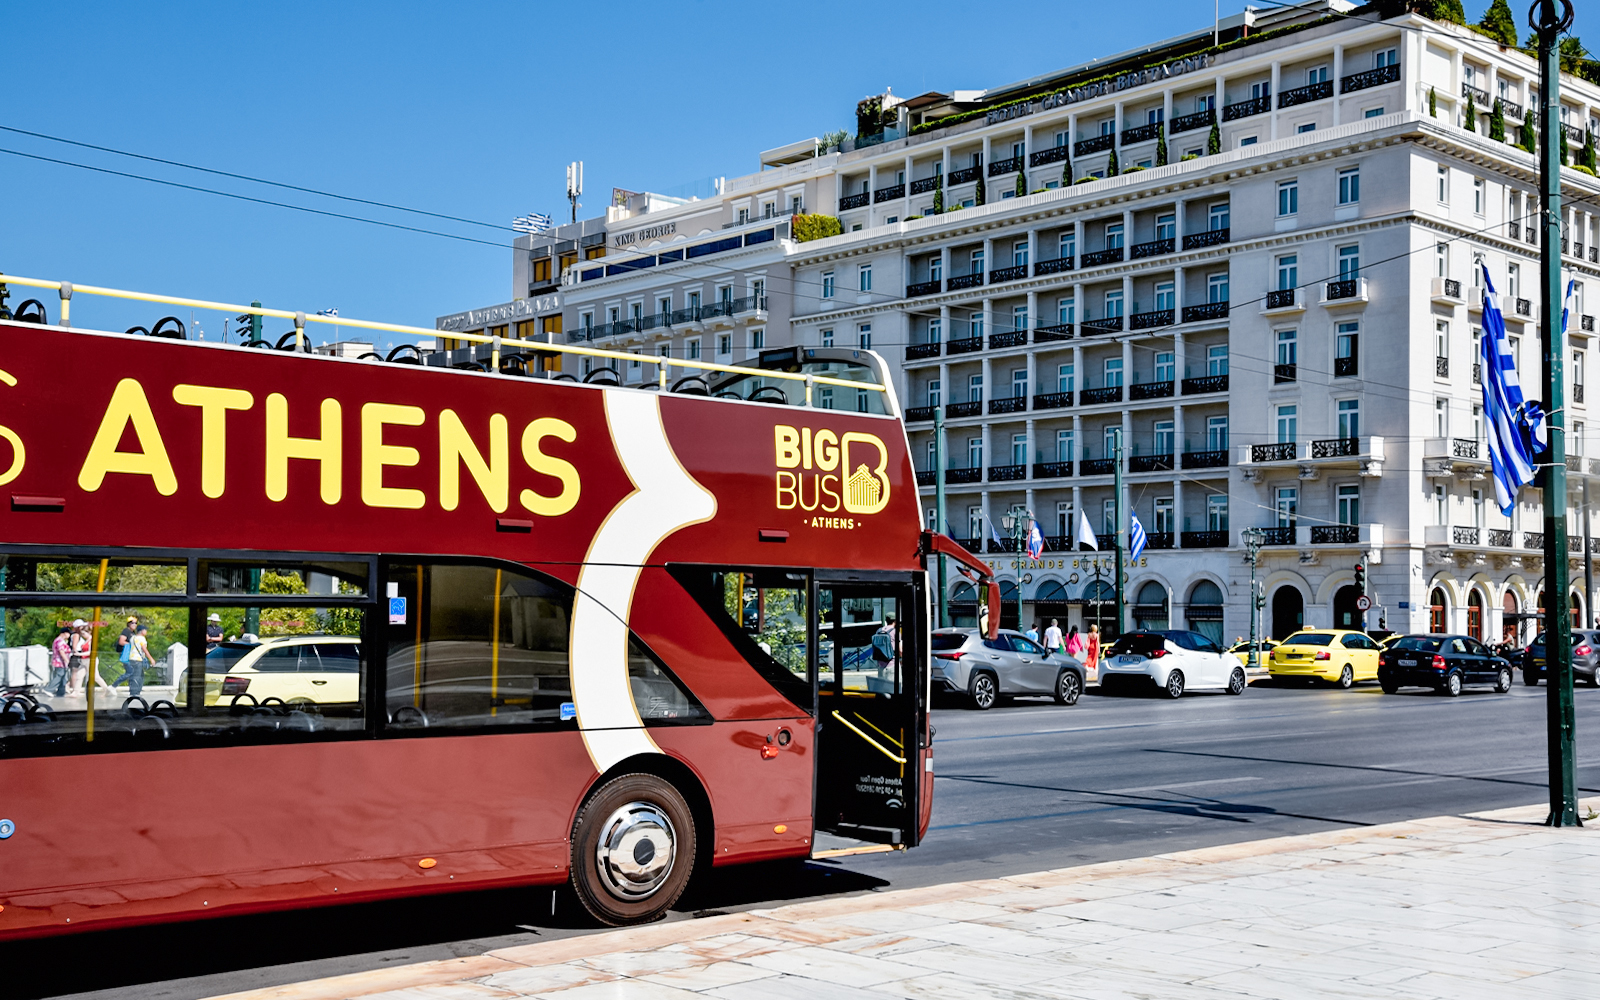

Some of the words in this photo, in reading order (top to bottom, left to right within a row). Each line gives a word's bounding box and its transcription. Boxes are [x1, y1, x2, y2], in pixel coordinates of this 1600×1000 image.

[985, 101, 1034, 126] HOTEL
[1041, 80, 1109, 110] GRANDE
[1116, 53, 1208, 91] BRETAGNE
[614, 231, 635, 247] KING
[638, 222, 676, 241] GEORGE
[516, 295, 559, 316] PLAZA
[78, 377, 582, 517] ATHENS
[774, 424, 840, 472] BIG
[775, 471, 841, 513] BUS
[811, 516, 855, 530] ATHENS
[1011, 559, 1064, 570] GRANDE
